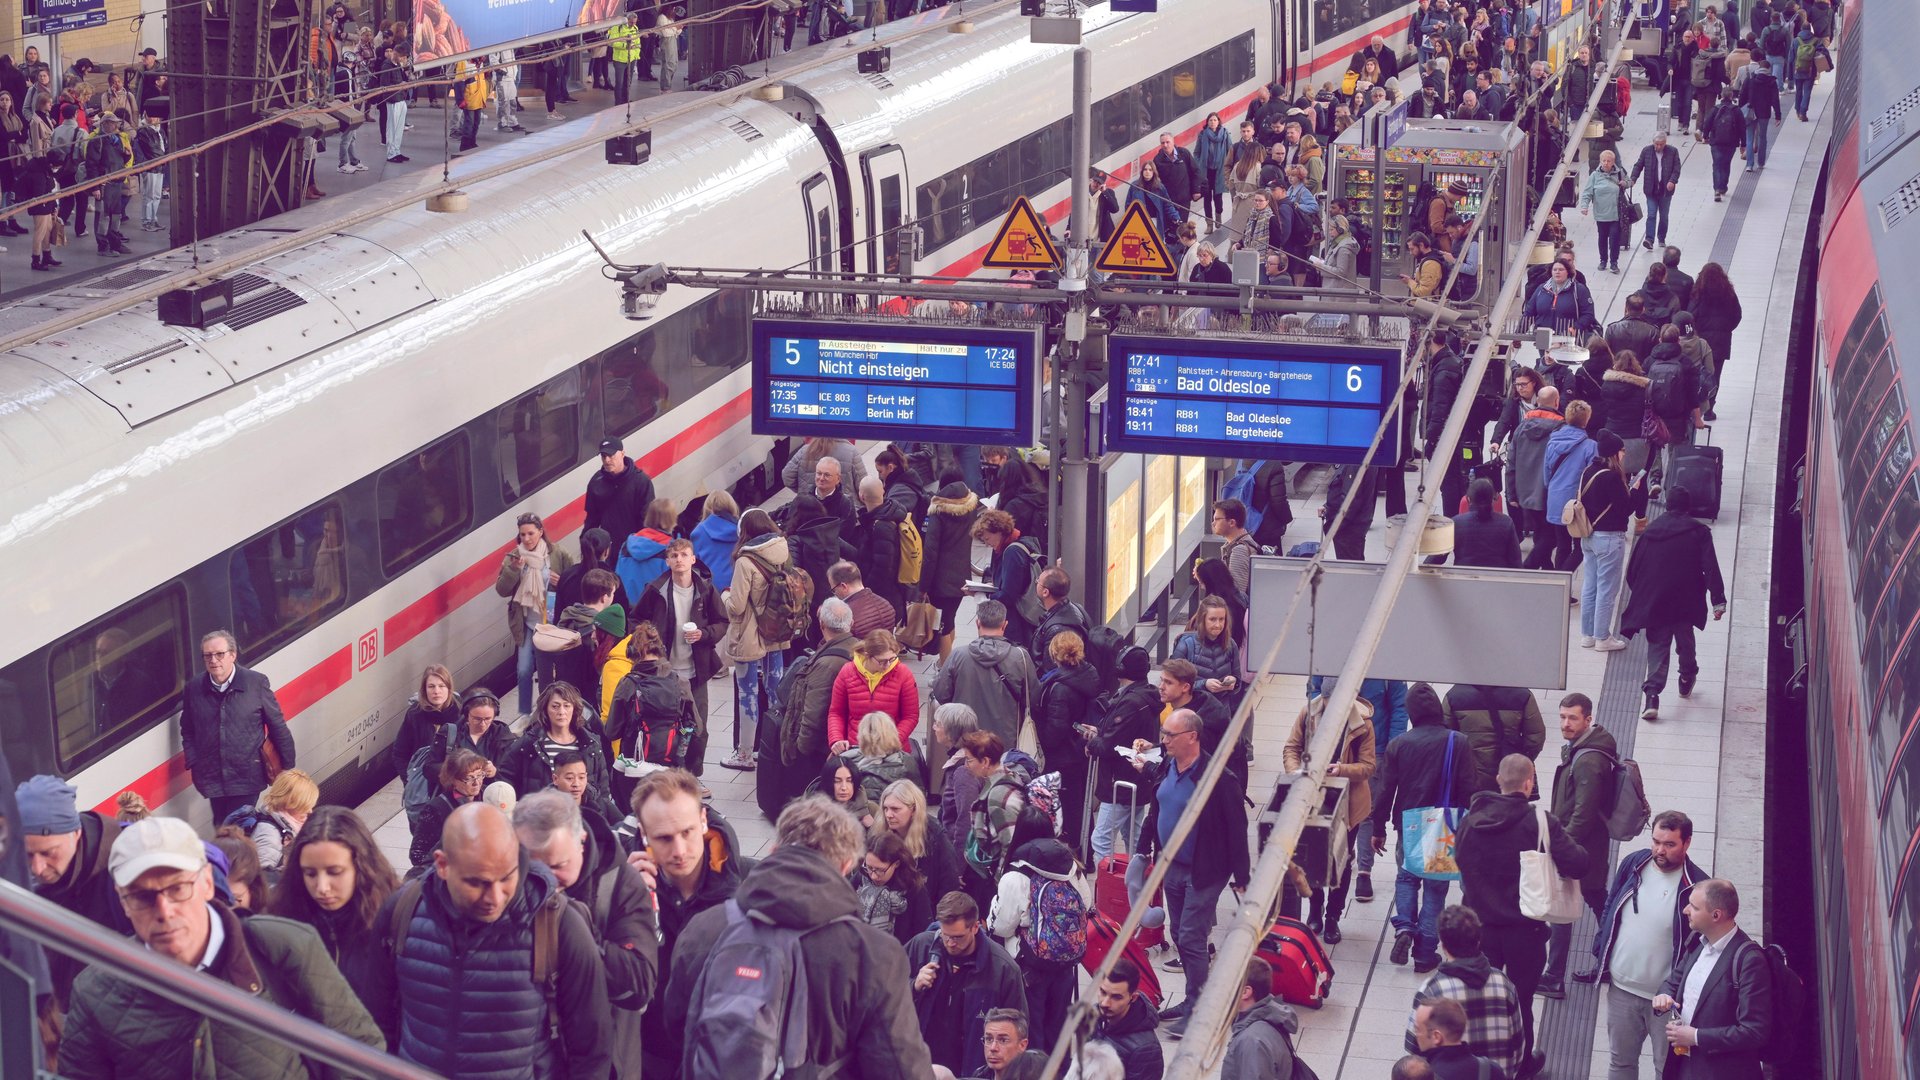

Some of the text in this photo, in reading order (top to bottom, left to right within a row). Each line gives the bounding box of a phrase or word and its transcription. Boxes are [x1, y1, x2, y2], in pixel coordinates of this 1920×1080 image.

[962, 174, 968, 200] 2
[786, 340, 800, 364] 5
[828, 341, 876, 350] Aussteigen
[834, 350, 864, 358] München
[866, 351, 879, 359] Hbf
[985, 349, 1015, 360] 17:24
[1129, 355, 1159, 368] 17:41
[820, 360, 928, 380] Nicht einsteigen
[1178, 367, 1213, 375] Rahlstedt
[1220, 369, 1262, 379] Ahrensburg
[1269, 371, 1312, 380] Bargteheide
[1347, 366, 1361, 391] 6
[1178, 377, 1270, 394] Bad Oldesloe
[772, 390, 914, 405] 17:35 ICE 803 Erfurt Hbf
[771, 404, 795, 413] 17:51
[819, 406, 826, 414] IC
[830, 407, 850, 415] 2075
[868, 408, 893, 418] Berlin
[898, 410, 913, 419] Hbf
[1127, 407, 1291, 424] 18:41 RB81 Bad Oldesloe
[1127, 421, 1283, 438] 19:11 RB81 Bargteheide
[360, 634, 376, 666] DB
[347, 710, 380, 742] 2412 043-9
